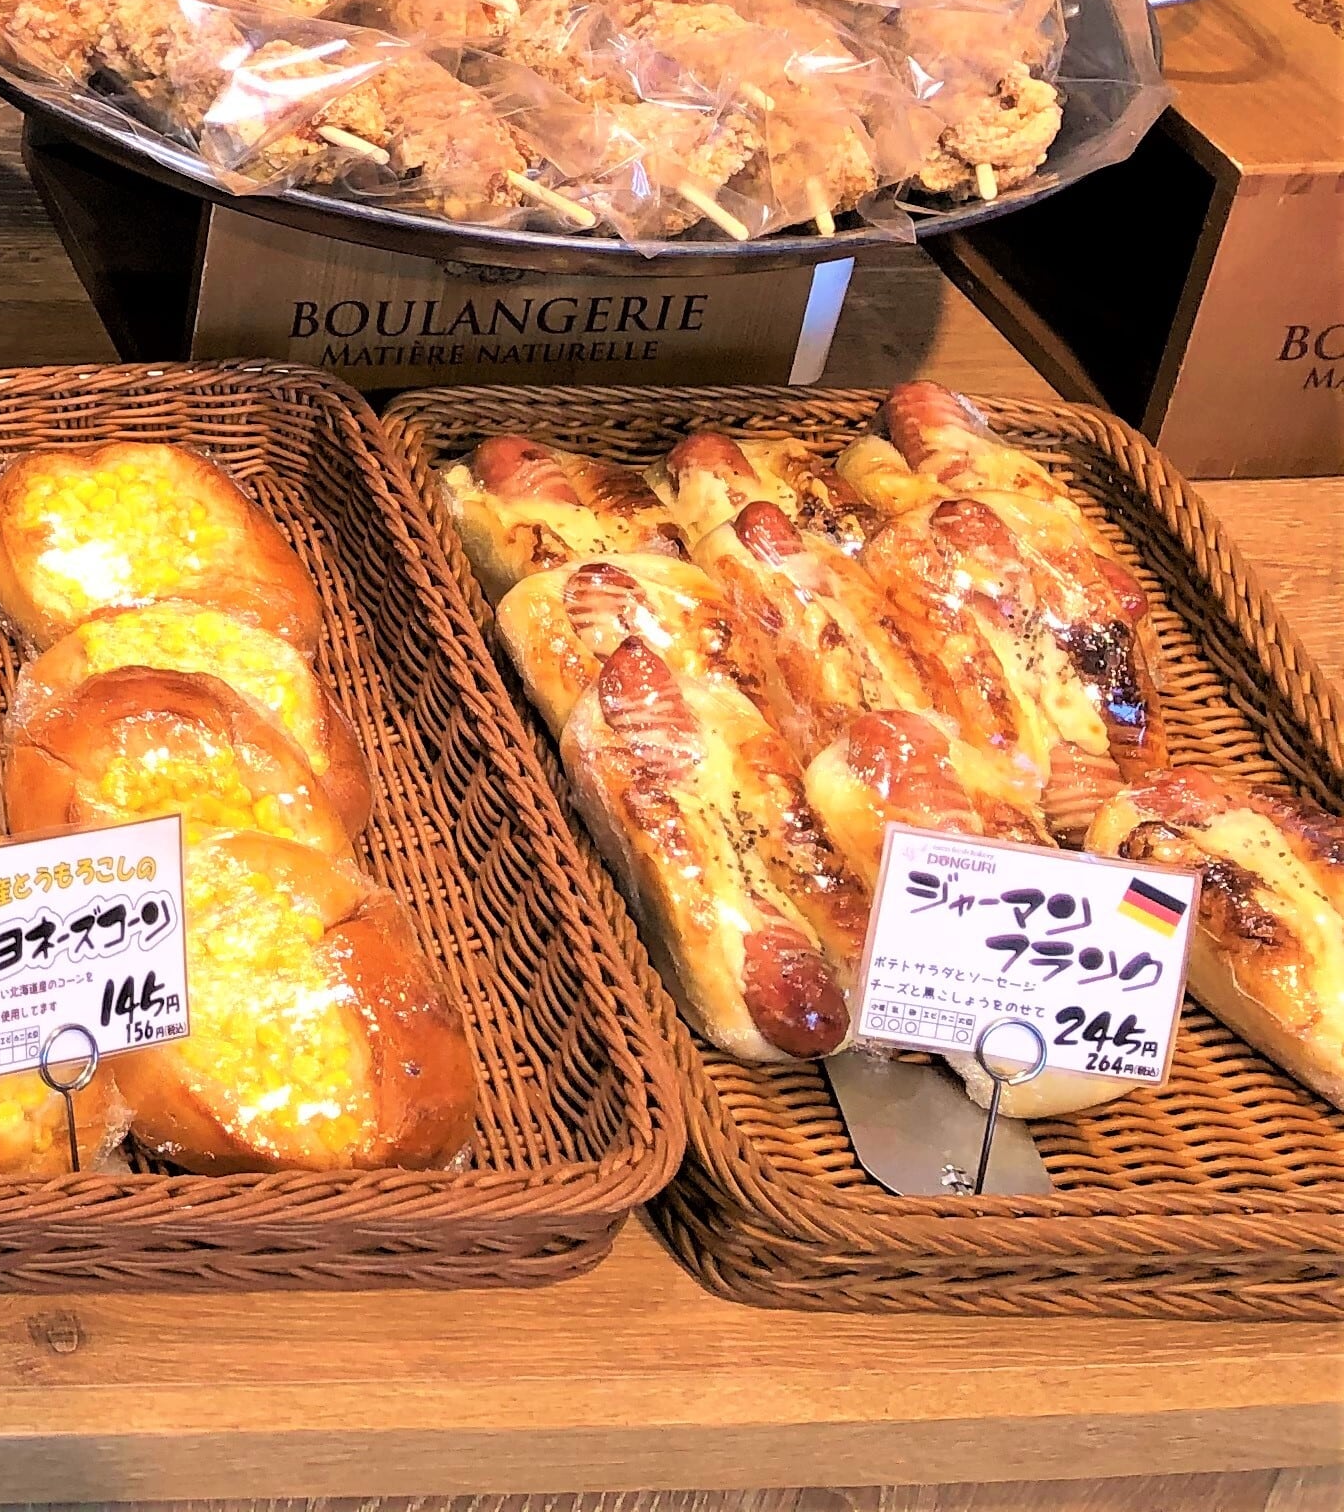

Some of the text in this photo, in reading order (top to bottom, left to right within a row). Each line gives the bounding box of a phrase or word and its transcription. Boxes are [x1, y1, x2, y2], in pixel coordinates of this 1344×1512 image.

[287, 293, 709, 340] BOULANGERIE
[319, 339, 659, 367] MATIÈRE NATURELLE
[926, 852, 997, 875] DONGURI
[905, 869, 1093, 936] ジャーマン
[873, 956, 1038, 993] ポテトサラダとソーセージ
[985, 933, 1164, 993] フランク
[100, 969, 181, 1028] 145円
[870, 978, 1045, 1019] チーズと黒こしょうをのせて
[1053, 1005, 1159, 1058] 245円
